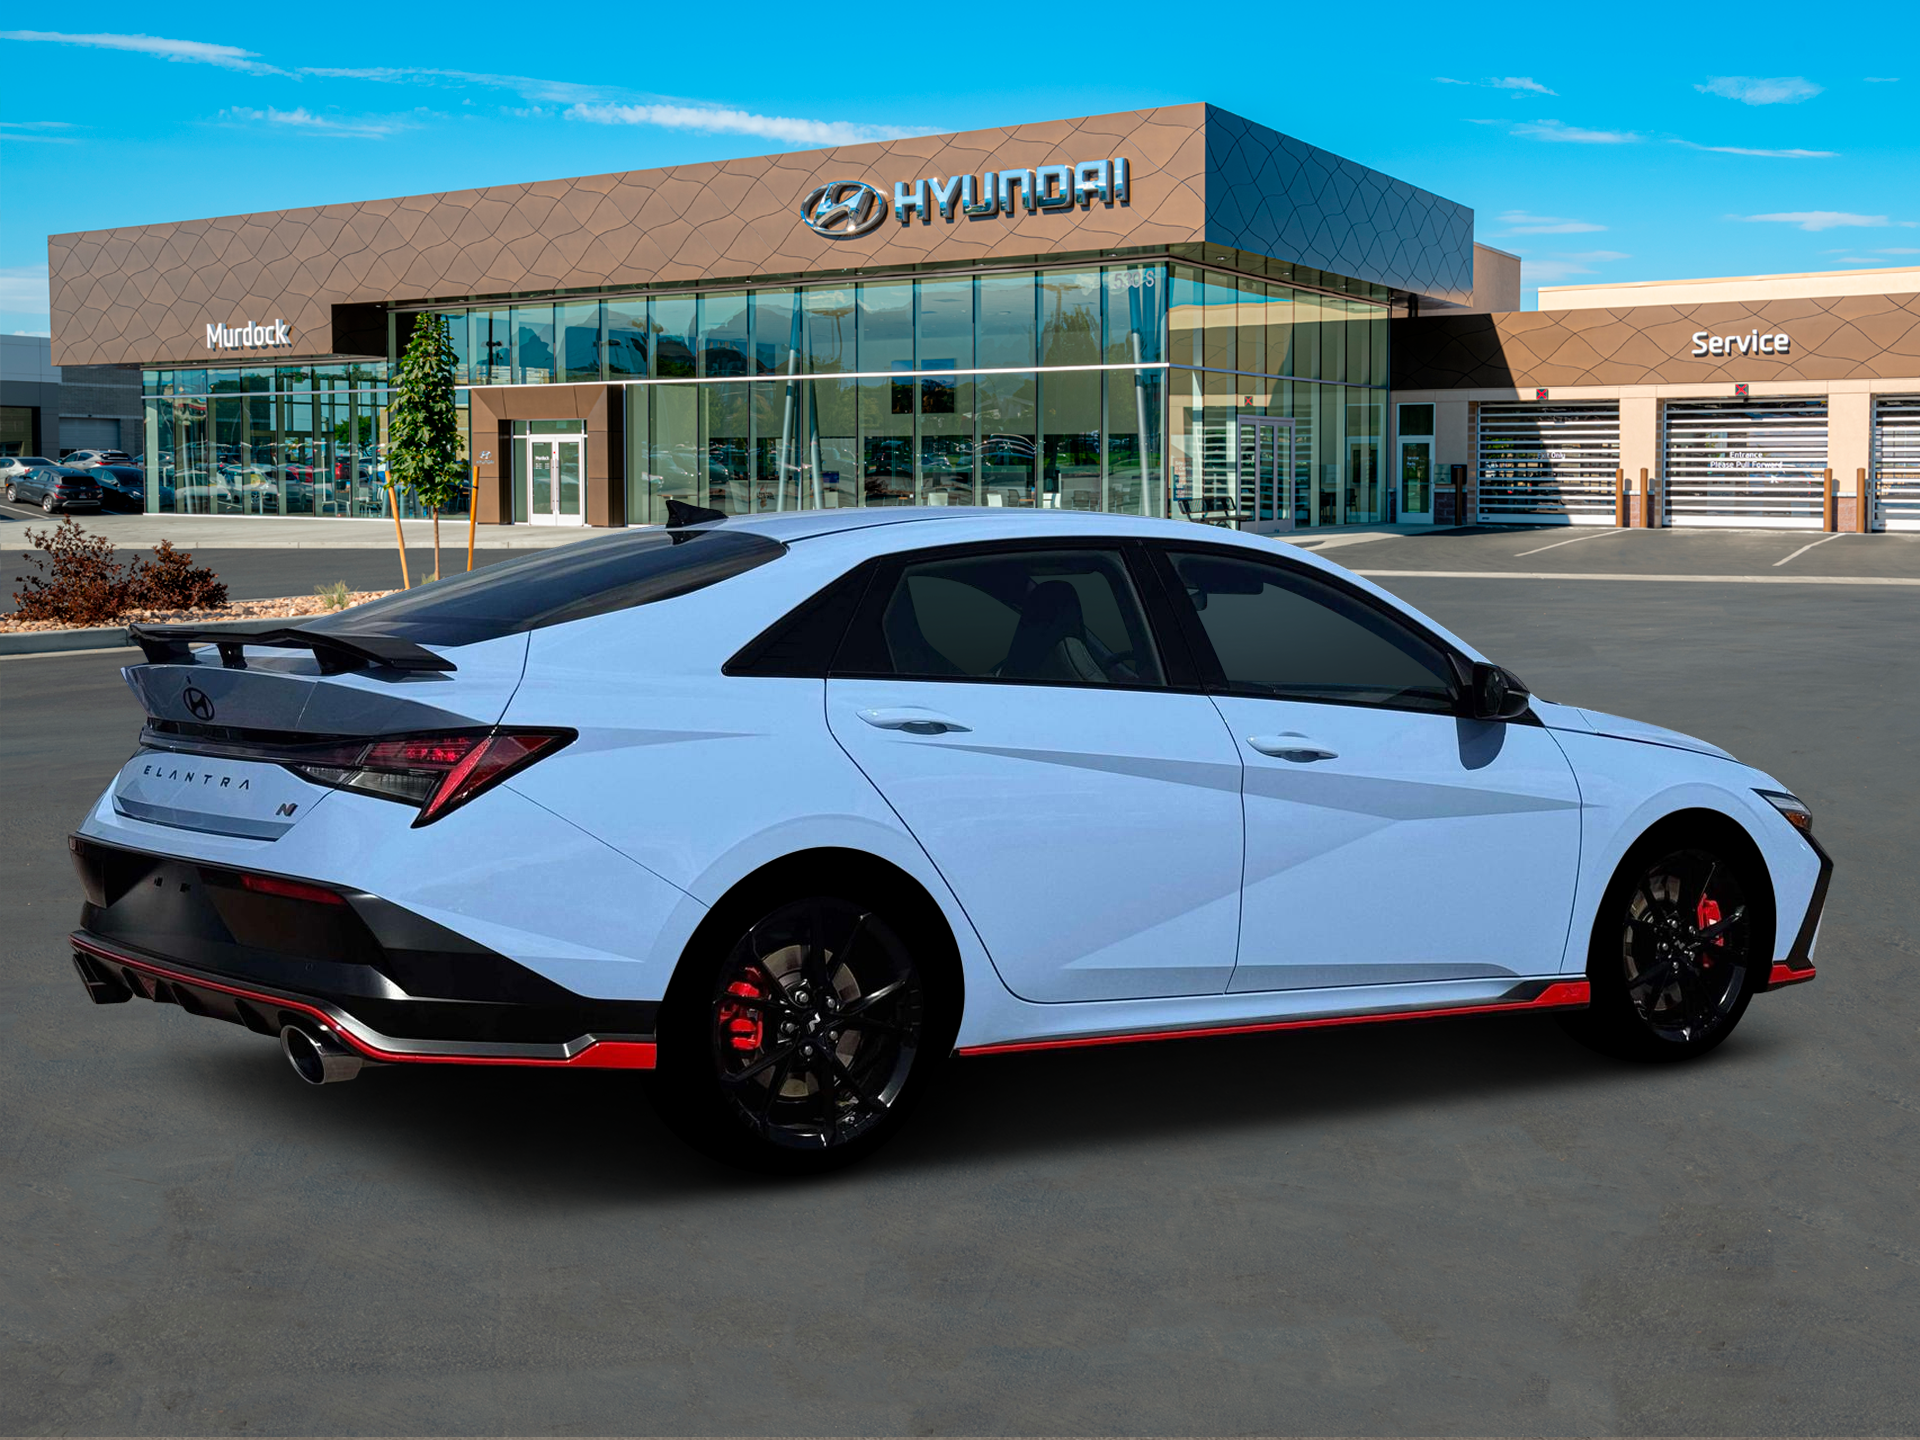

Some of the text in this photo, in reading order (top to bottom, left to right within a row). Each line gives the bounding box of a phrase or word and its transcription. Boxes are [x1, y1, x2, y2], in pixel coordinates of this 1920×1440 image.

[894, 157, 1130, 224] HYUNDAI
[1114, 270, 1155, 289] 530 S
[206, 318, 292, 349] Murdock
[1691, 329, 1791, 356] Service
[1710, 461, 1735, 469] Please
[1735, 461, 1750, 469] Pull
[1729, 451, 1763, 459] Entrance
[143, 765, 250, 790] ELANTRA
[275, 802, 298, 817] N
